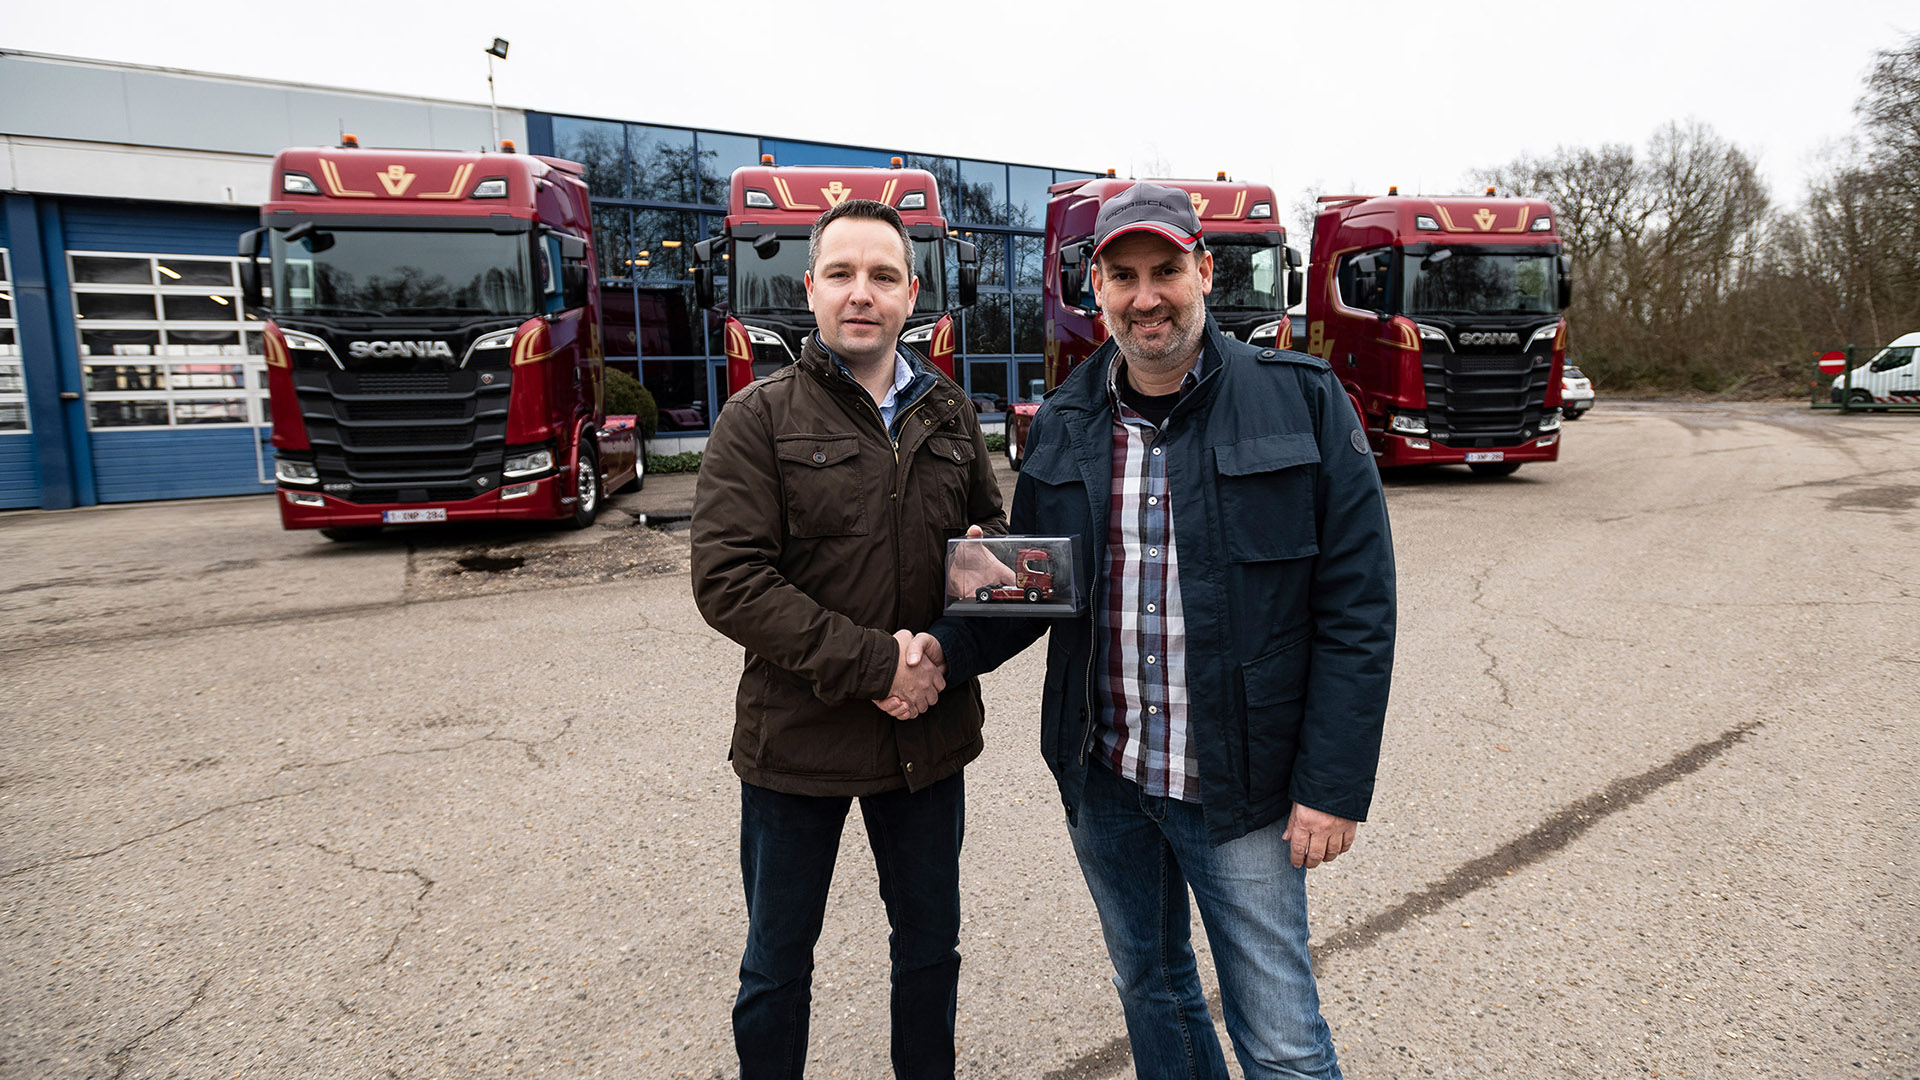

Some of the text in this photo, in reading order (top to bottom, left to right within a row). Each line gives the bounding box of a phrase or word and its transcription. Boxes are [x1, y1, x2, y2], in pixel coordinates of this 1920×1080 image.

[1105, 200, 1180, 221] PORSCHE
[1459, 332, 1520, 344] SCANIA
[349, 340, 454, 358] SCANIA
